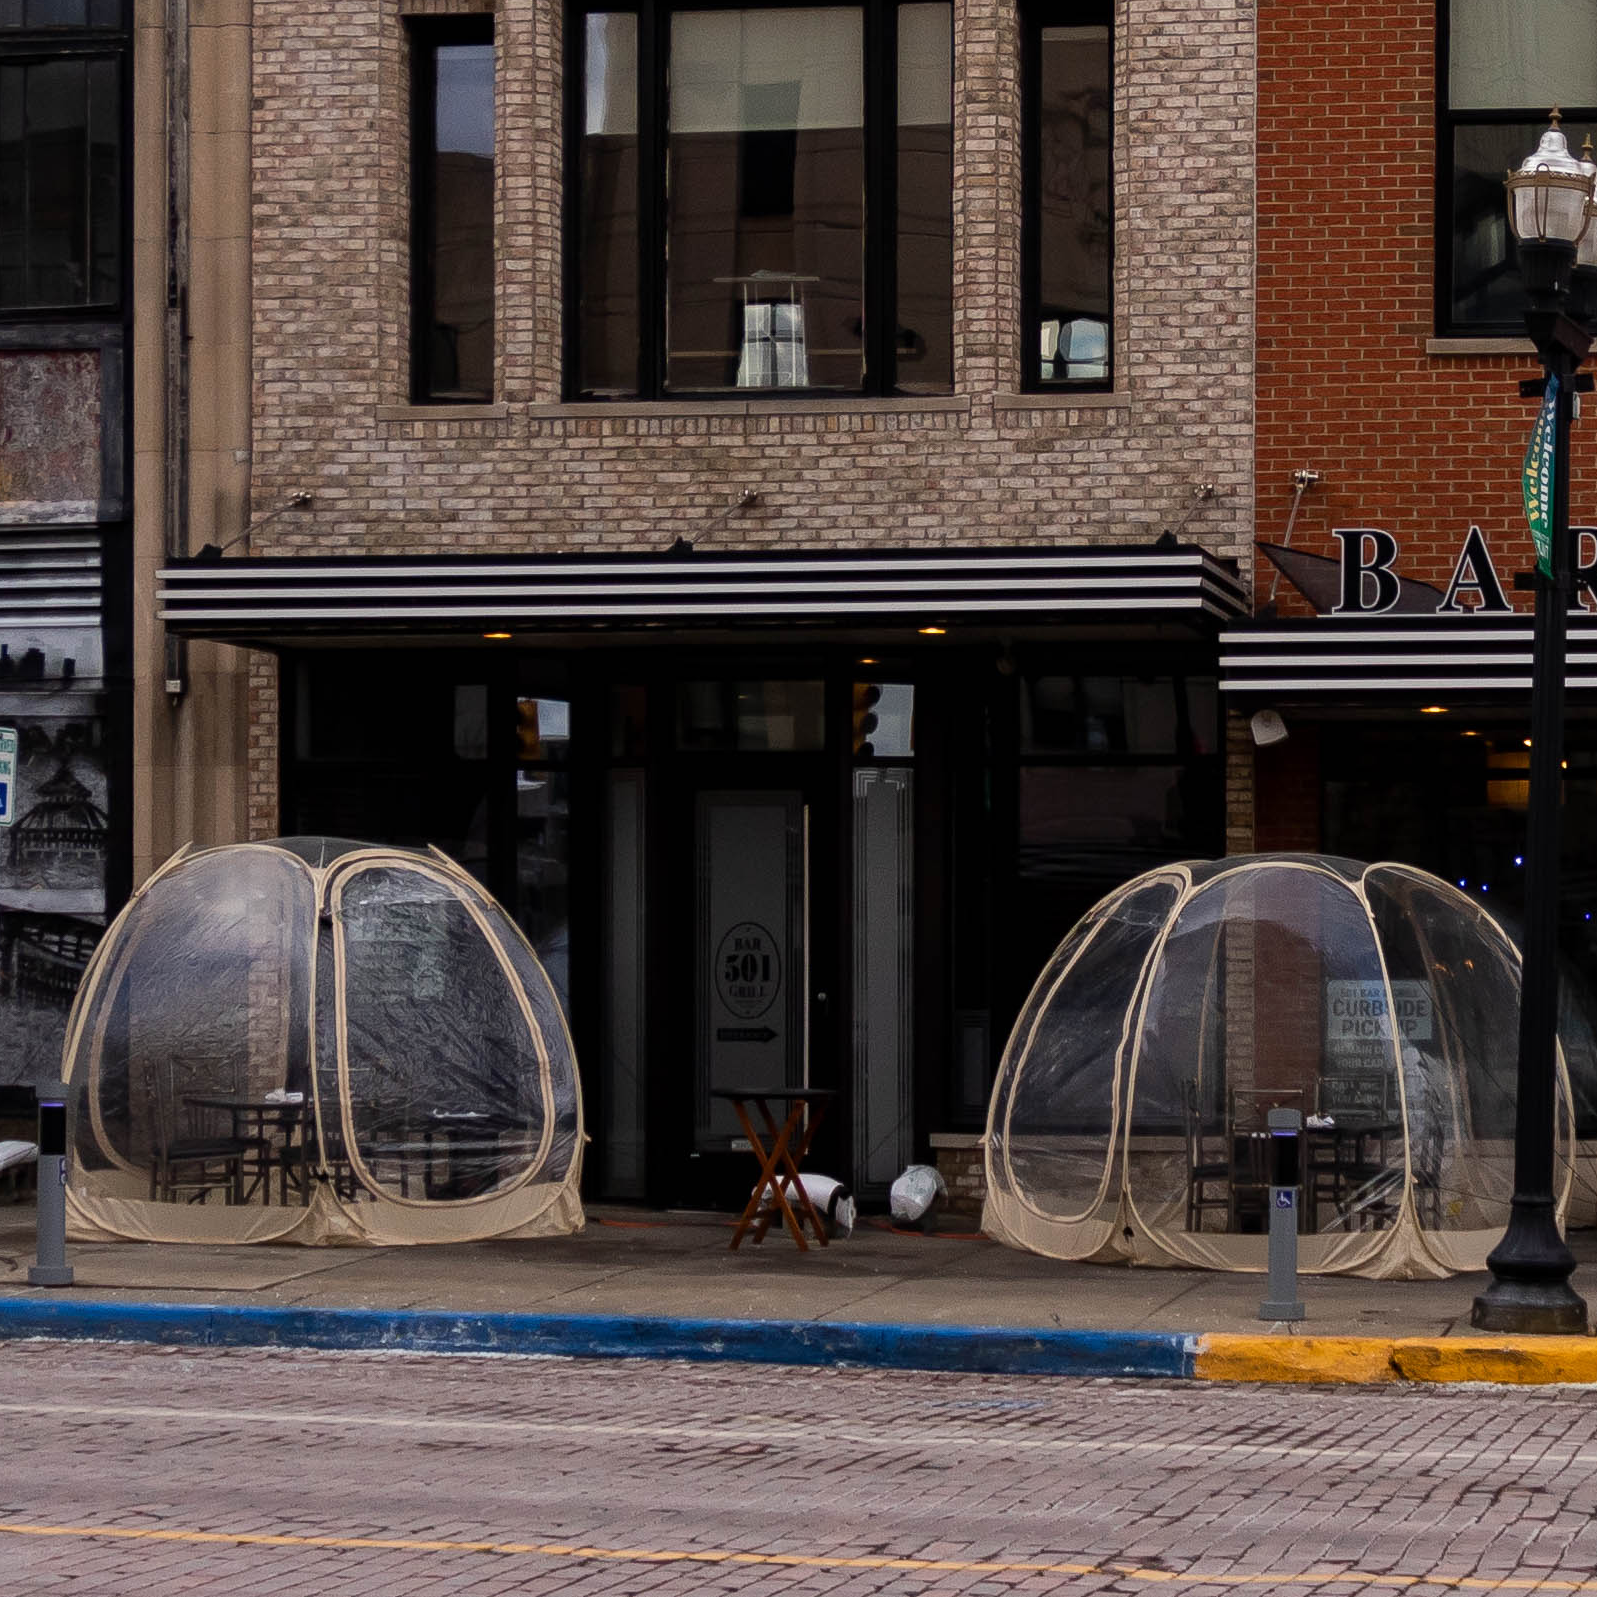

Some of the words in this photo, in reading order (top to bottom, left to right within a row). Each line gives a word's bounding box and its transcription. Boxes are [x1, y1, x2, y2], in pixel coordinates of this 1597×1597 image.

[734, 938, 762, 951] BAR
[724, 953, 772, 982] 501
[729, 986, 765, 998] GRILL
[1332, 998, 1430, 1017] CURBIDE
